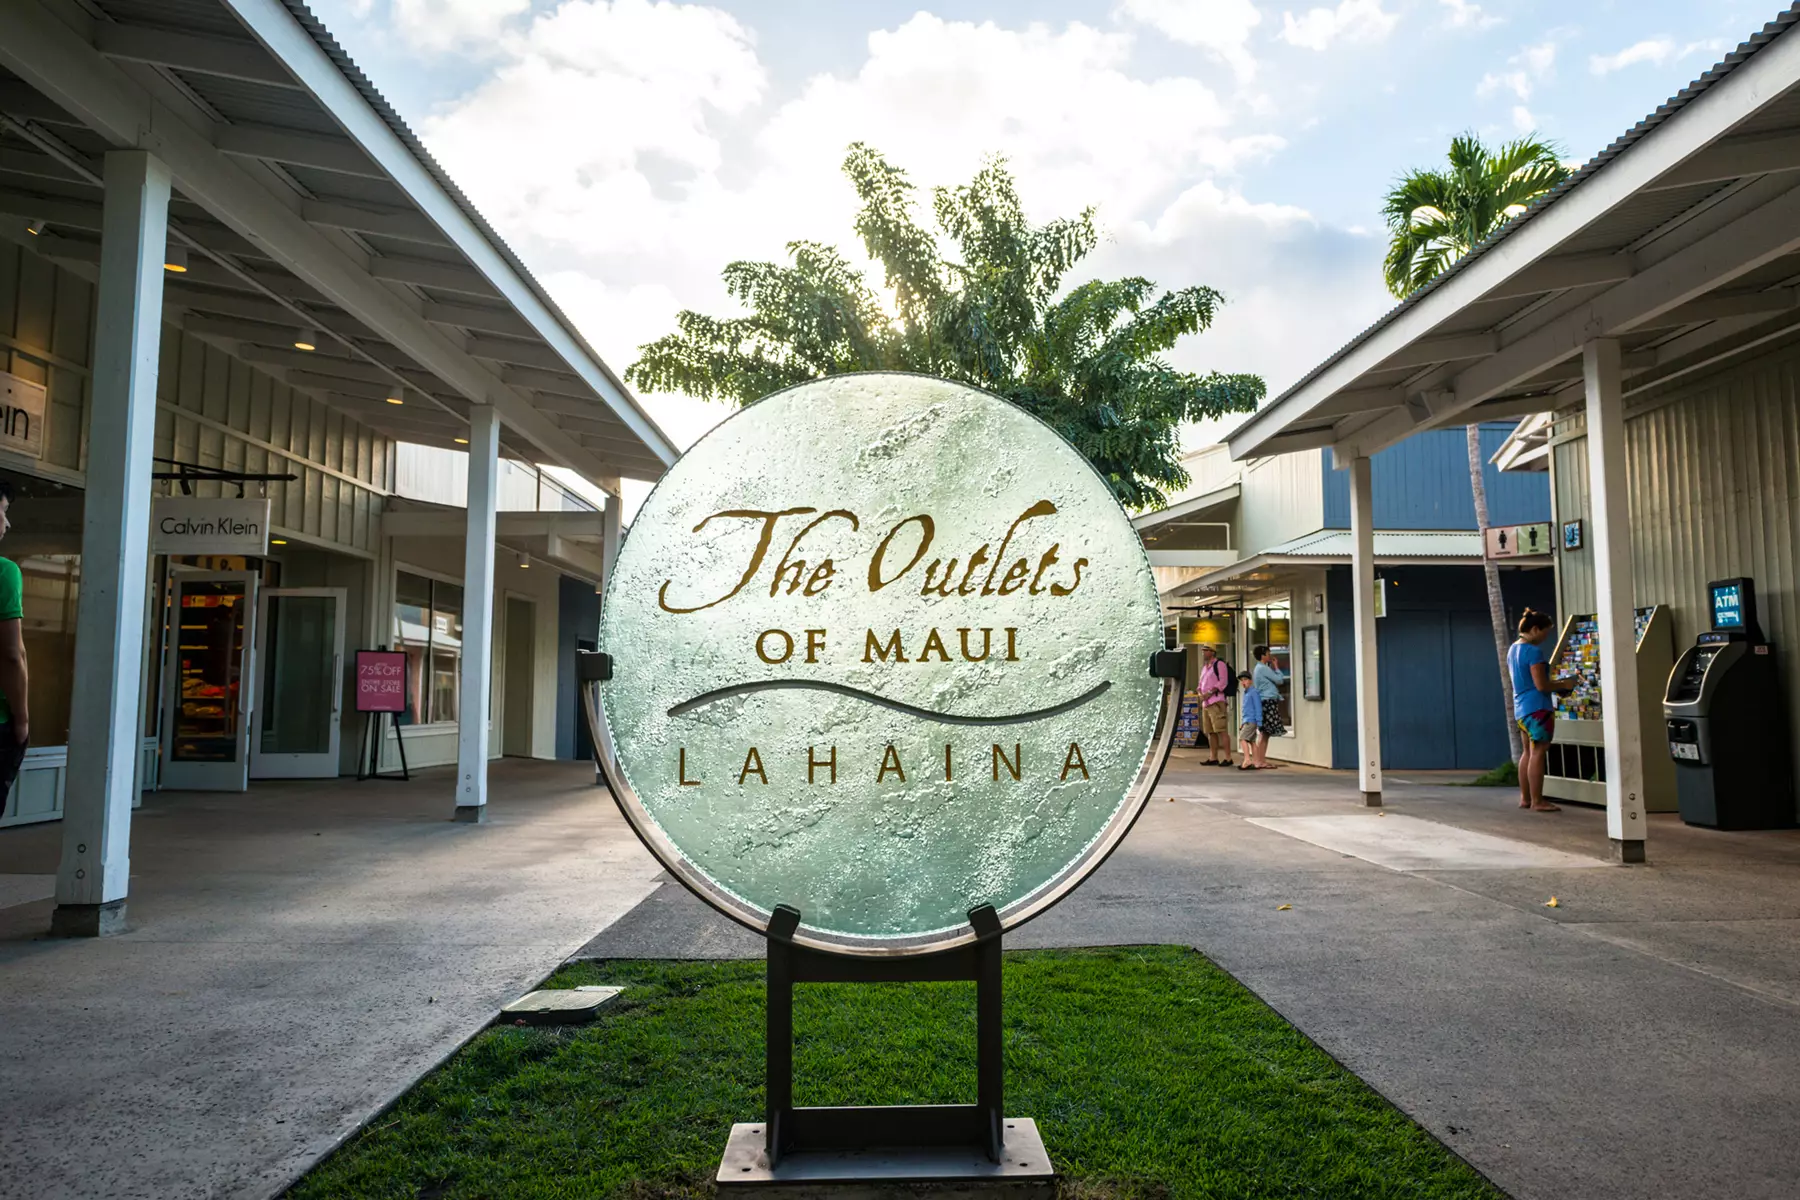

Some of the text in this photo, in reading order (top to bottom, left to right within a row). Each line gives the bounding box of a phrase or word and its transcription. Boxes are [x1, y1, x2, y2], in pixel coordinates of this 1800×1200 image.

[0, 389, 29, 440] in
[160, 516, 258, 535] Calvin Klein
[658, 499, 1089, 615] The Outlets
[1715, 594, 1739, 609] ATM
[754, 626, 1021, 665] OF MAUI
[383, 665, 401, 676] OFF
[381, 684, 400, 693] SALE
[679, 742, 1090, 787] LAHAINA
